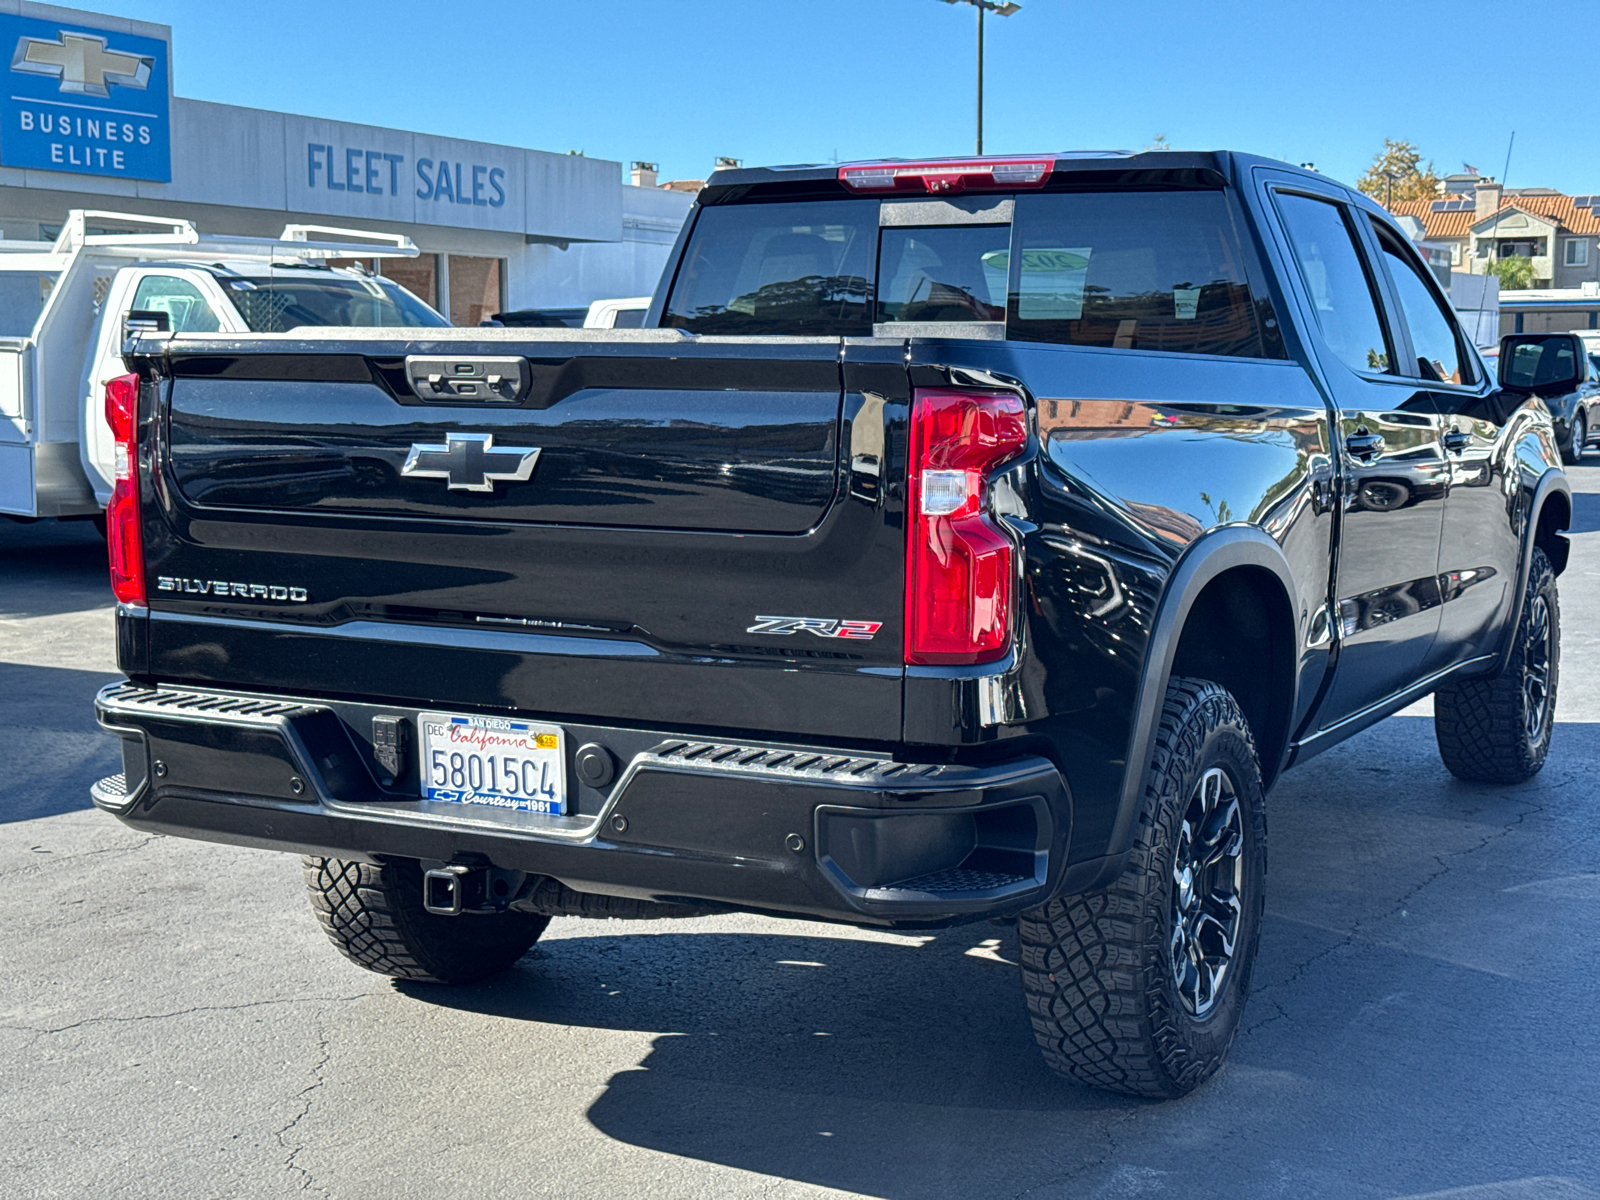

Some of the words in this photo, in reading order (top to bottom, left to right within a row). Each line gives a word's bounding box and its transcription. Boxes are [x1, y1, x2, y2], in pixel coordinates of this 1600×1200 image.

[20, 111, 151, 146] BUSINESS
[51, 143, 125, 170] ELITE
[307, 142, 404, 197] FLEET
[416, 157, 506, 208] SALES
[158, 576, 308, 602] SILVERADO
[746, 615, 883, 640] ZR2
[428, 723, 444, 737] DEC
[450, 724, 538, 751] California
[468, 718, 485, 728] SAN
[486, 719, 511, 731] DIEGO
[544, 736, 554, 745] 25
[432, 750, 555, 799] 58015C4
[461, 790, 520, 810] Courtesy
[526, 799, 551, 814] 1961
